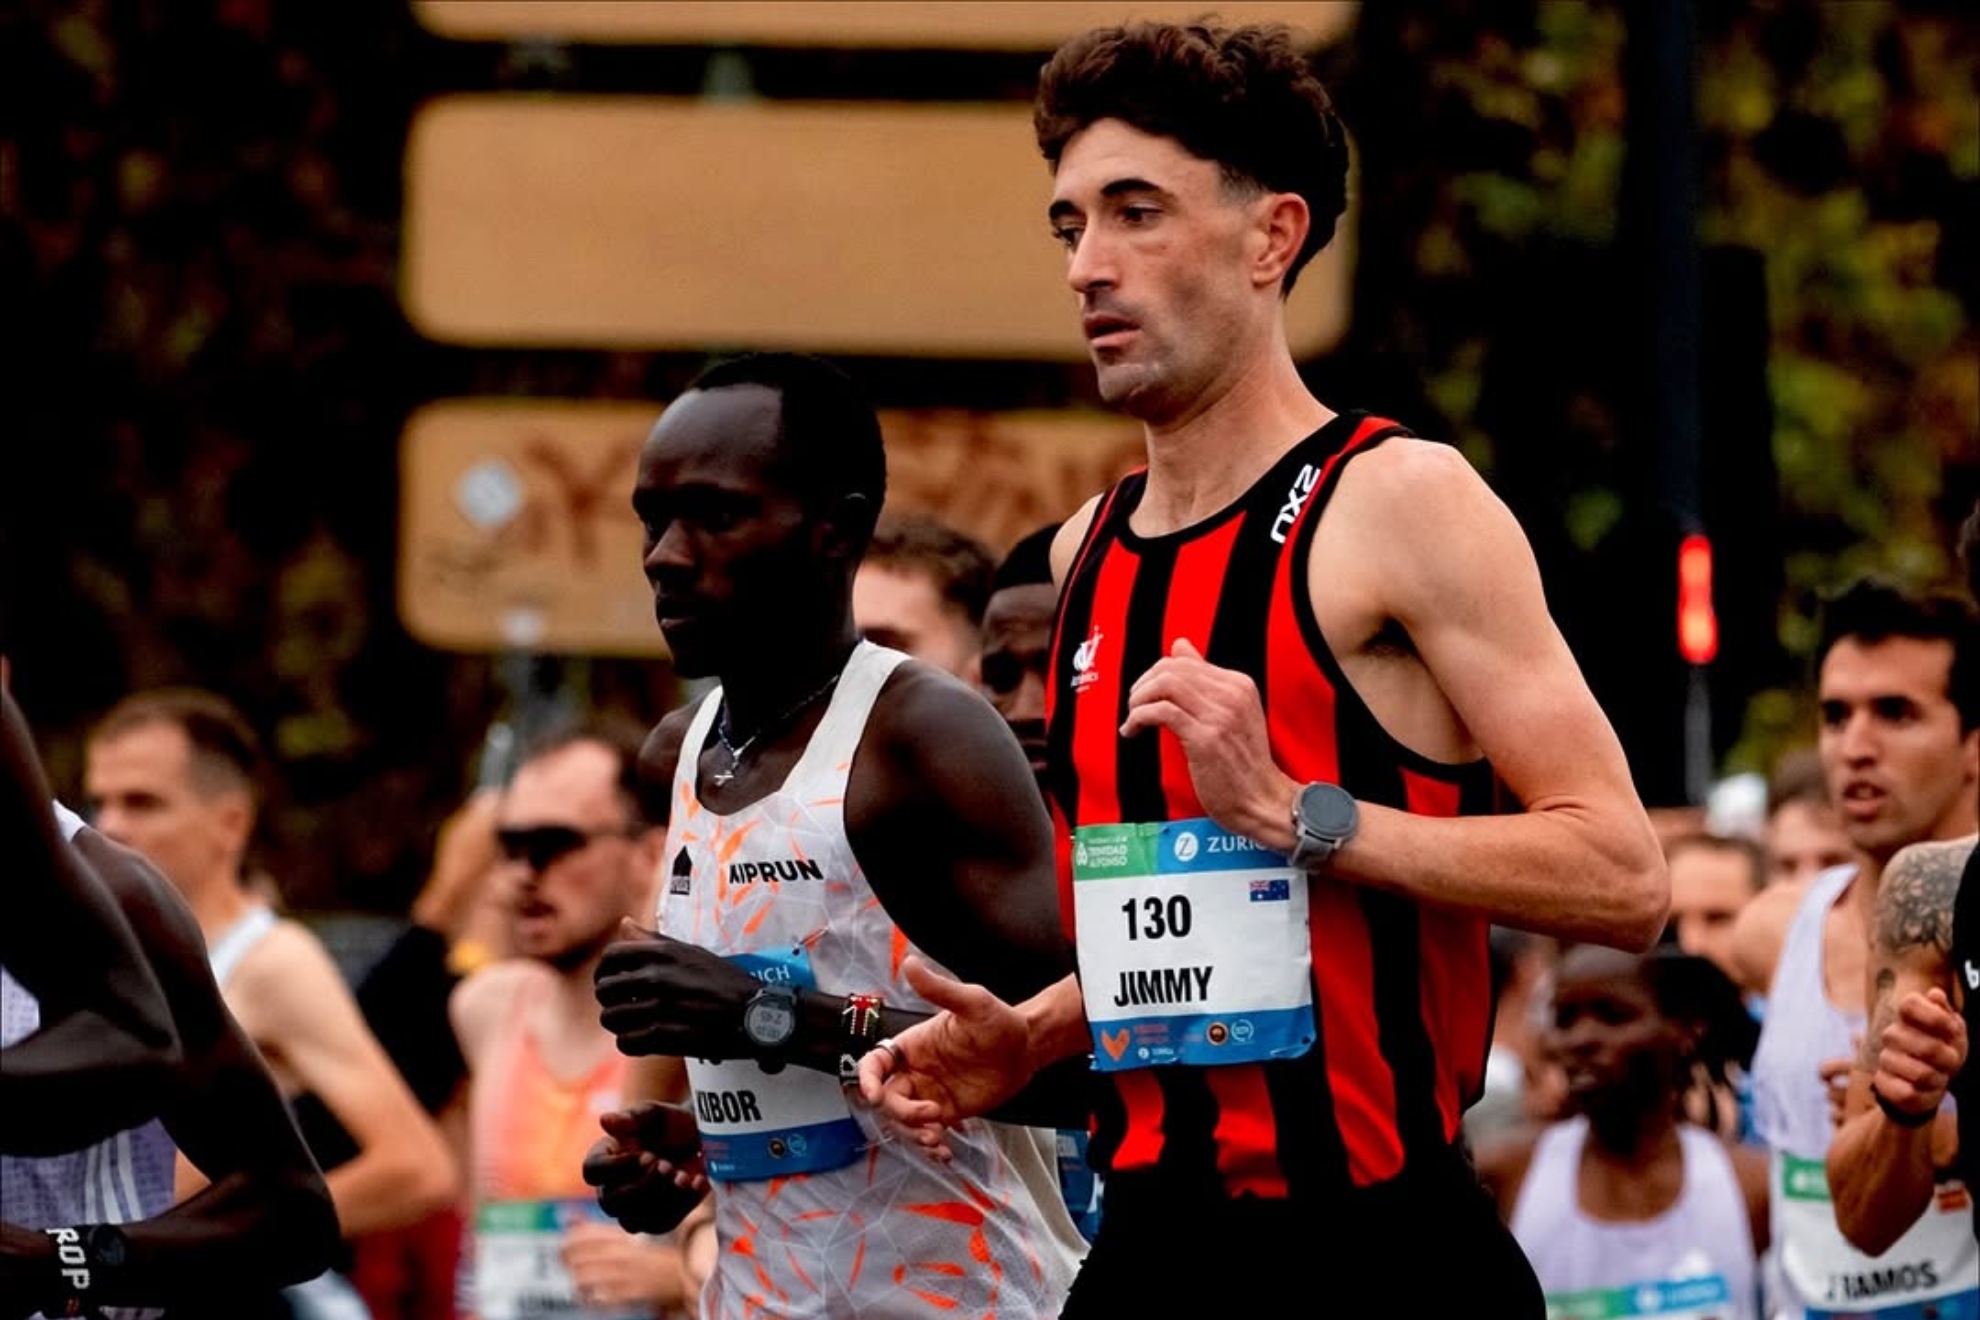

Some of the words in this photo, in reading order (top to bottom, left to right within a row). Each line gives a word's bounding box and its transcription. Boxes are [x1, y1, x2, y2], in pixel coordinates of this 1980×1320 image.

[1270, 463, 1322, 544] 2XU
[1121, 895, 1192, 941] 130
[1113, 966, 1214, 1008] JIMMY
